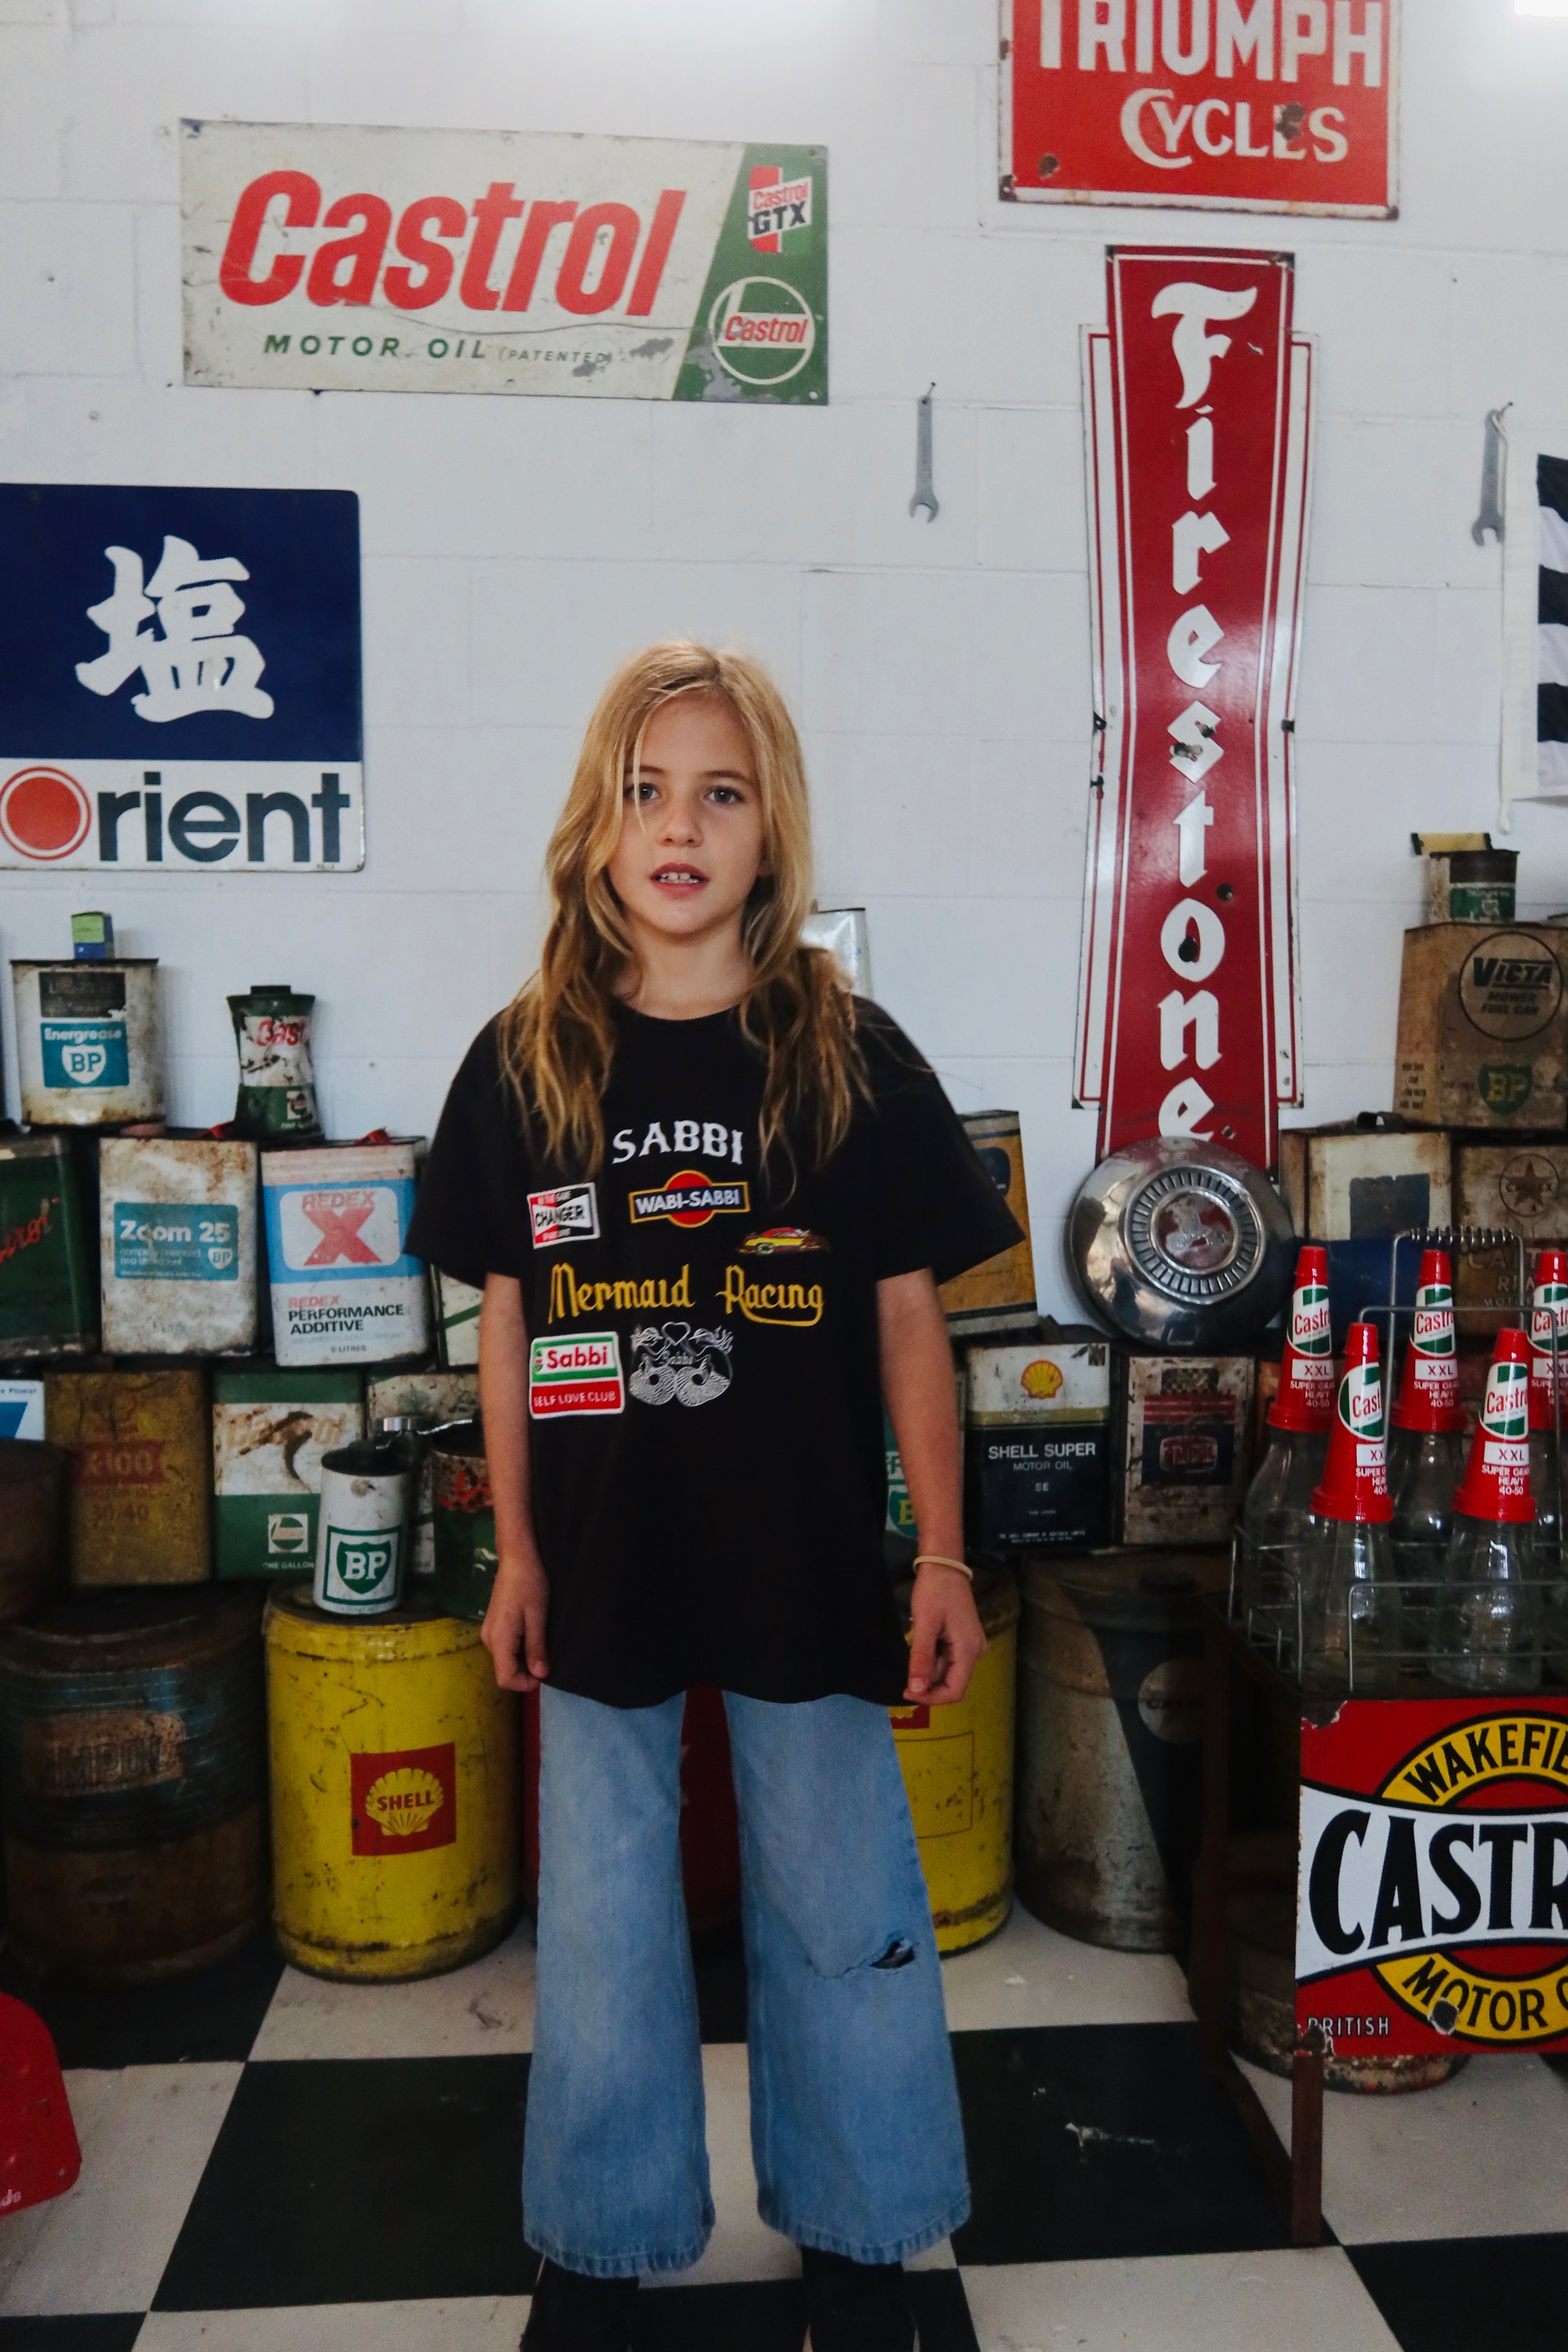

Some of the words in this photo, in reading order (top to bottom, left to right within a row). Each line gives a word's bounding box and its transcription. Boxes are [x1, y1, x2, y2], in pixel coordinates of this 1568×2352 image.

[1120, 89, 1348, 169] CYCLES
[753, 181, 809, 210] Castrol
[752, 201, 806, 236] GTX
[219, 169, 686, 317] Castrol
[725, 315, 808, 343] Castrol
[263, 334, 400, 358] MOTOR
[428, 338, 486, 359] OIL
[75, 535, 274, 723] 塩
[1152, 282, 1257, 1141] Firestone
[69, 1053, 101, 1072] BP
[612, 1120, 743, 1165] SABBI
[302, 1191, 375, 1212] REDEX
[635, 1188, 740, 1215] WABI-SABBI
[120, 1220, 191, 1242] Zoom
[199, 1221, 230, 1243] 25
[288, 1294, 340, 1307] REDEX
[548, 1262, 696, 1324] Mermaid
[716, 1265, 824, 1326] Racing
[288, 1303, 404, 1321] PERFORMANCE
[1295, 1308, 1330, 1334] Castr
[1416, 1311, 1453, 1334] Castr
[291, 1319, 364, 1335] ADDITIVE
[547, 1345, 608, 1369] Sabbi
[1428, 1365, 1454, 1376] XXL
[1414, 1381, 1439, 1390] SUPER
[1429, 1390, 1453, 1399] HEAVY
[533, 1395, 556, 1407] SELF
[558, 1392, 586, 1405] LOVE
[588, 1391, 616, 1403] CLUB
[1353, 1388, 1382, 1418] Cast
[1487, 1387, 1528, 1414] Castr
[989, 1445, 1038, 1459] SHELL
[1044, 1442, 1096, 1458] SUPER
[1498, 1448, 1525, 1461] XXL
[1013, 1461, 1050, 1471] MOTOR
[1055, 1461, 1073, 1470] OIL
[1356, 1467, 1381, 1477] SUPER
[1481, 1465, 1510, 1476] SUPER
[1498, 1475, 1524, 1486] HEAVY
[344, 1550, 388, 1580] BP
[377, 1788, 435, 1811] SHELL
[1309, 1809, 1568, 1955] CASTR
[1402, 1957, 1548, 2032] MOTOR
